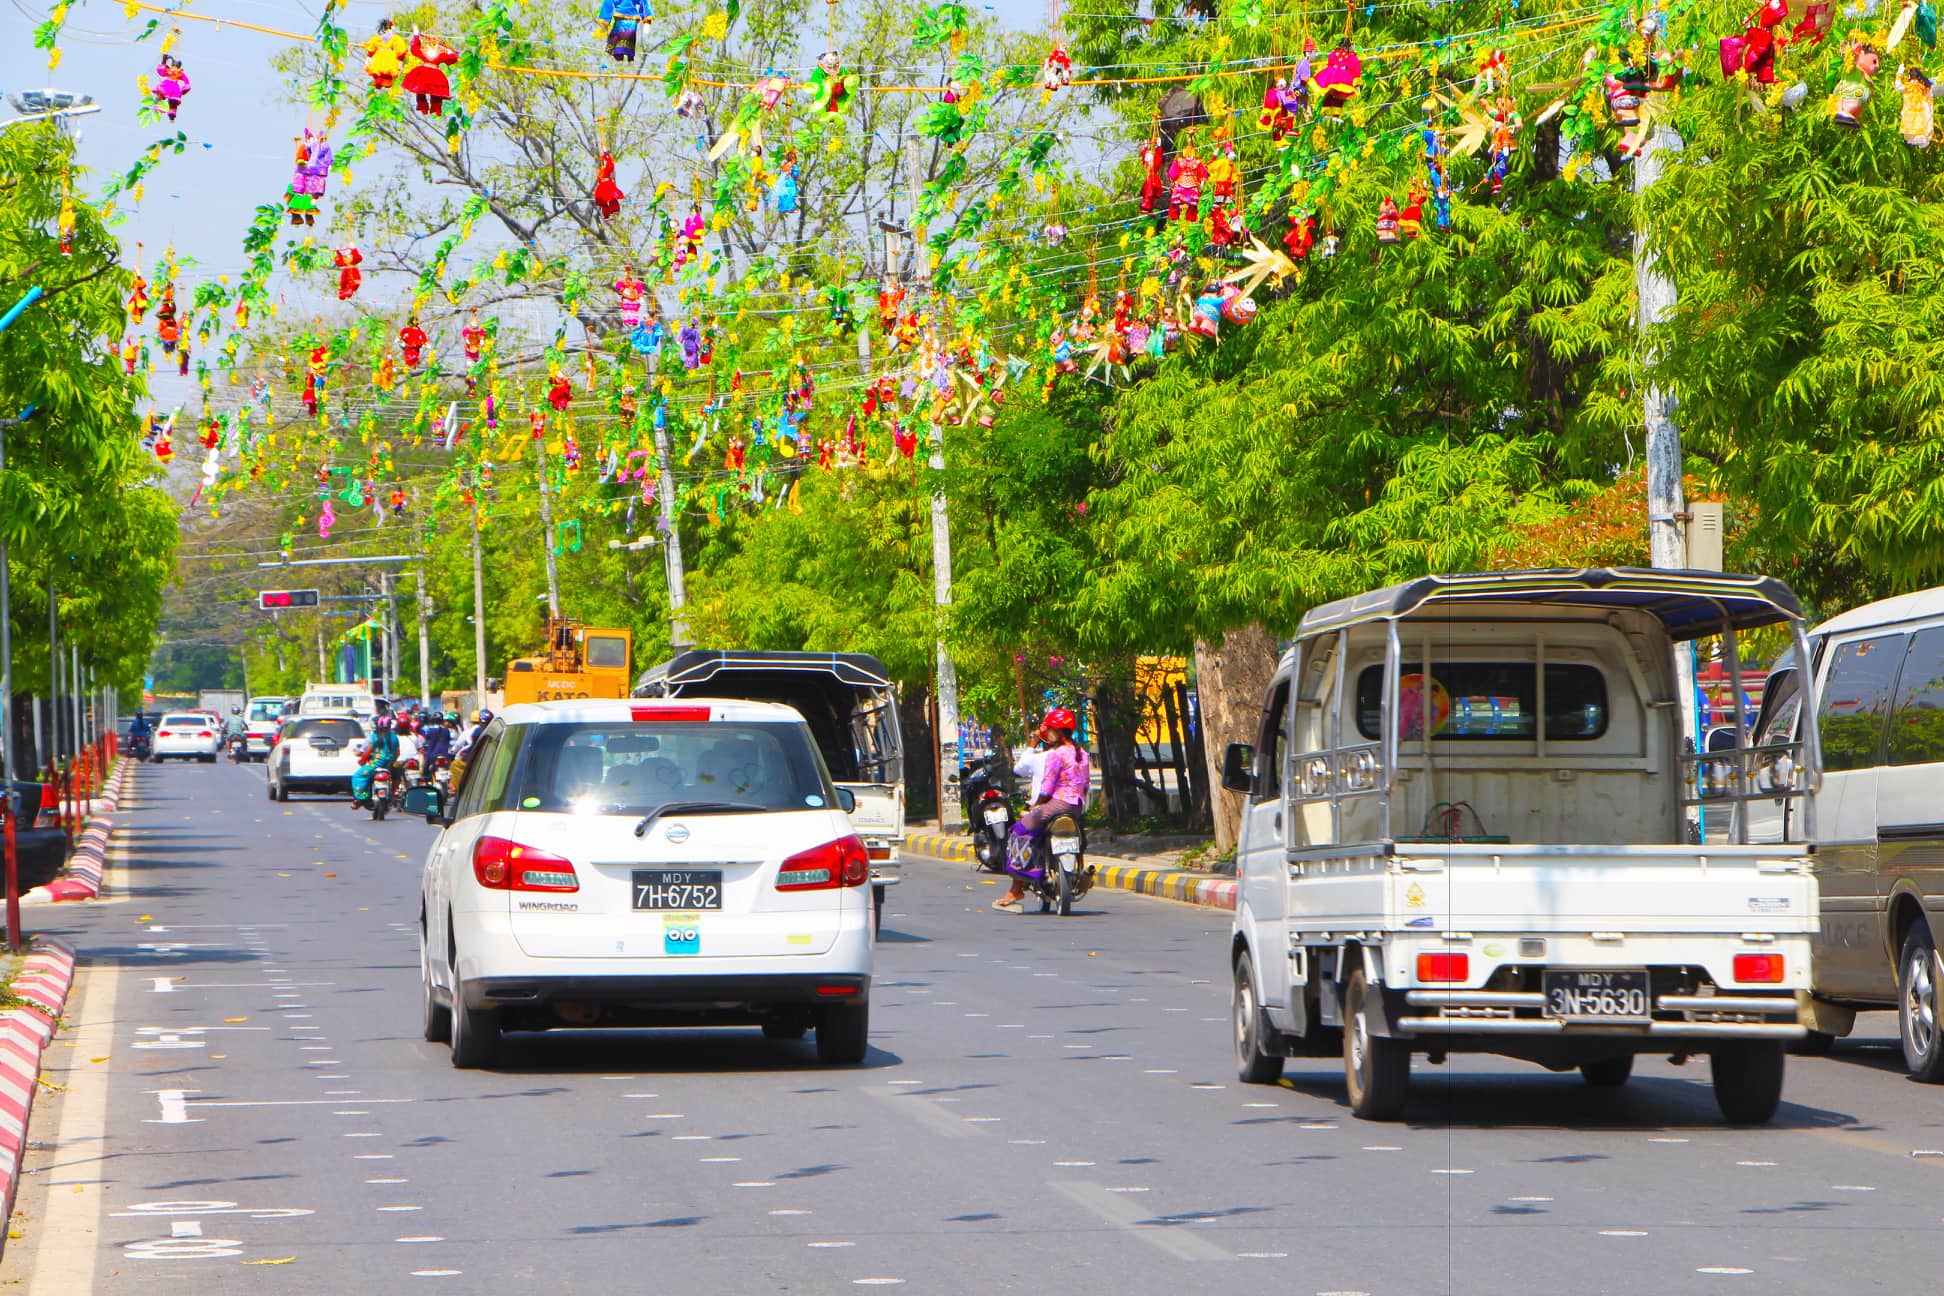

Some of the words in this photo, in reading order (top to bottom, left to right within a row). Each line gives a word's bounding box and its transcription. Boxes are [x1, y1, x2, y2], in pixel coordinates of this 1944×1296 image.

[536, 690, 590, 702] KATO
[662, 872, 692, 884] MDY
[636, 885, 719, 909] 7H-6752
[518, 901, 579, 912] WINGROAD
[1577, 973, 1614, 986] MDY
[1550, 988, 1645, 1015] 3N-5630
